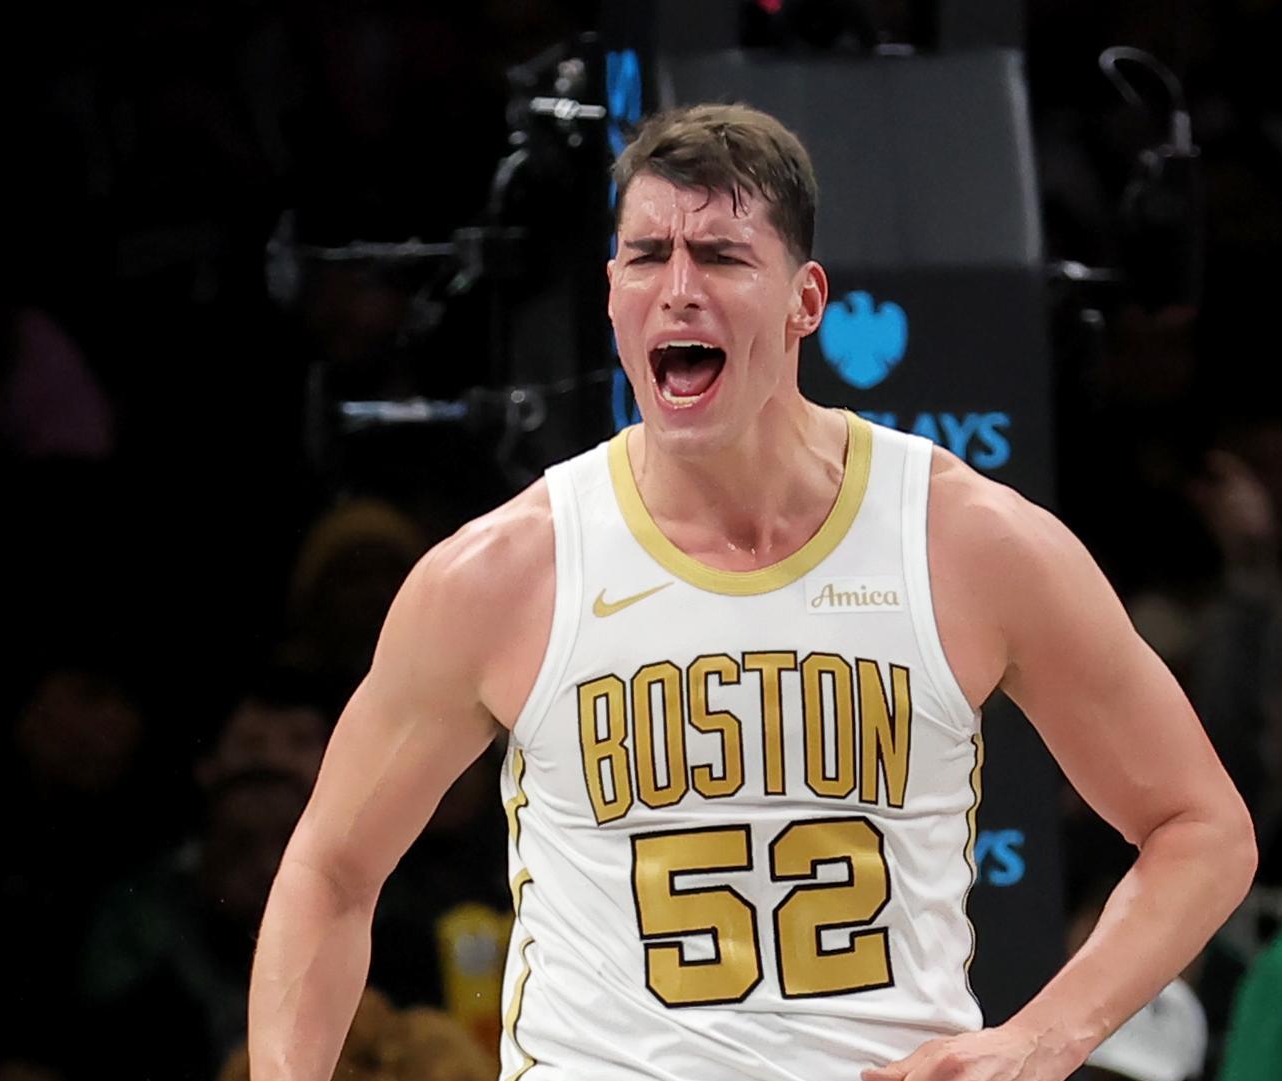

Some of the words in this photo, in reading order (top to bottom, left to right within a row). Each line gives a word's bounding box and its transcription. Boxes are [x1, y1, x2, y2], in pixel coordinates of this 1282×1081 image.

[811, 583, 900, 608] Amica
[577, 650, 913, 826] BOSTON
[630, 816, 895, 1008] 52
